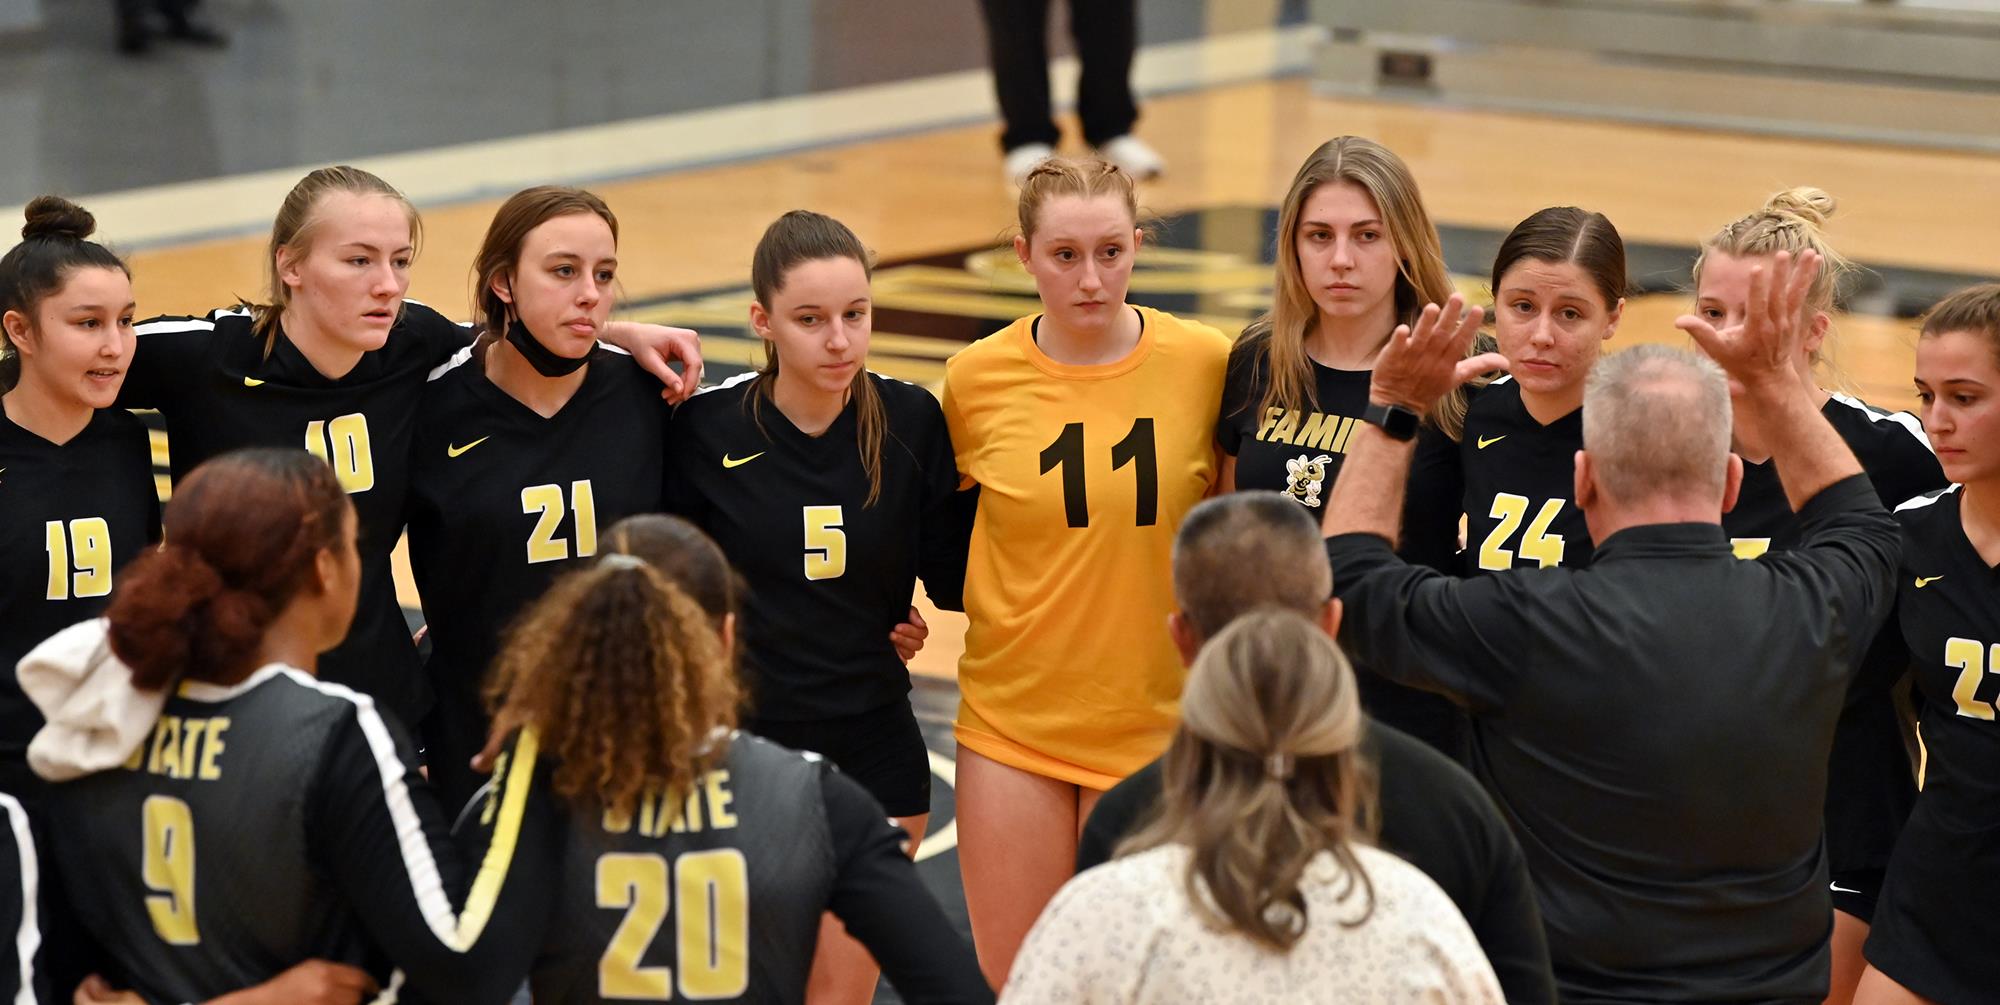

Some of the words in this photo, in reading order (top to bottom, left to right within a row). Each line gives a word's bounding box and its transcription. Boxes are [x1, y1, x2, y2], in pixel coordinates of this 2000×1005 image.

[1039, 417, 1158, 528] 11
[46, 516, 112, 600] 19
[521, 479, 598, 564] 21
[804, 505, 846, 580] 5
[1479, 492, 1567, 571] 24
[1945, 636, 2000, 721] 2
[122, 714, 232, 780] TATE
[602, 768, 738, 838] TATE
[141, 794, 201, 945] 9
[595, 847, 749, 1000] 20
